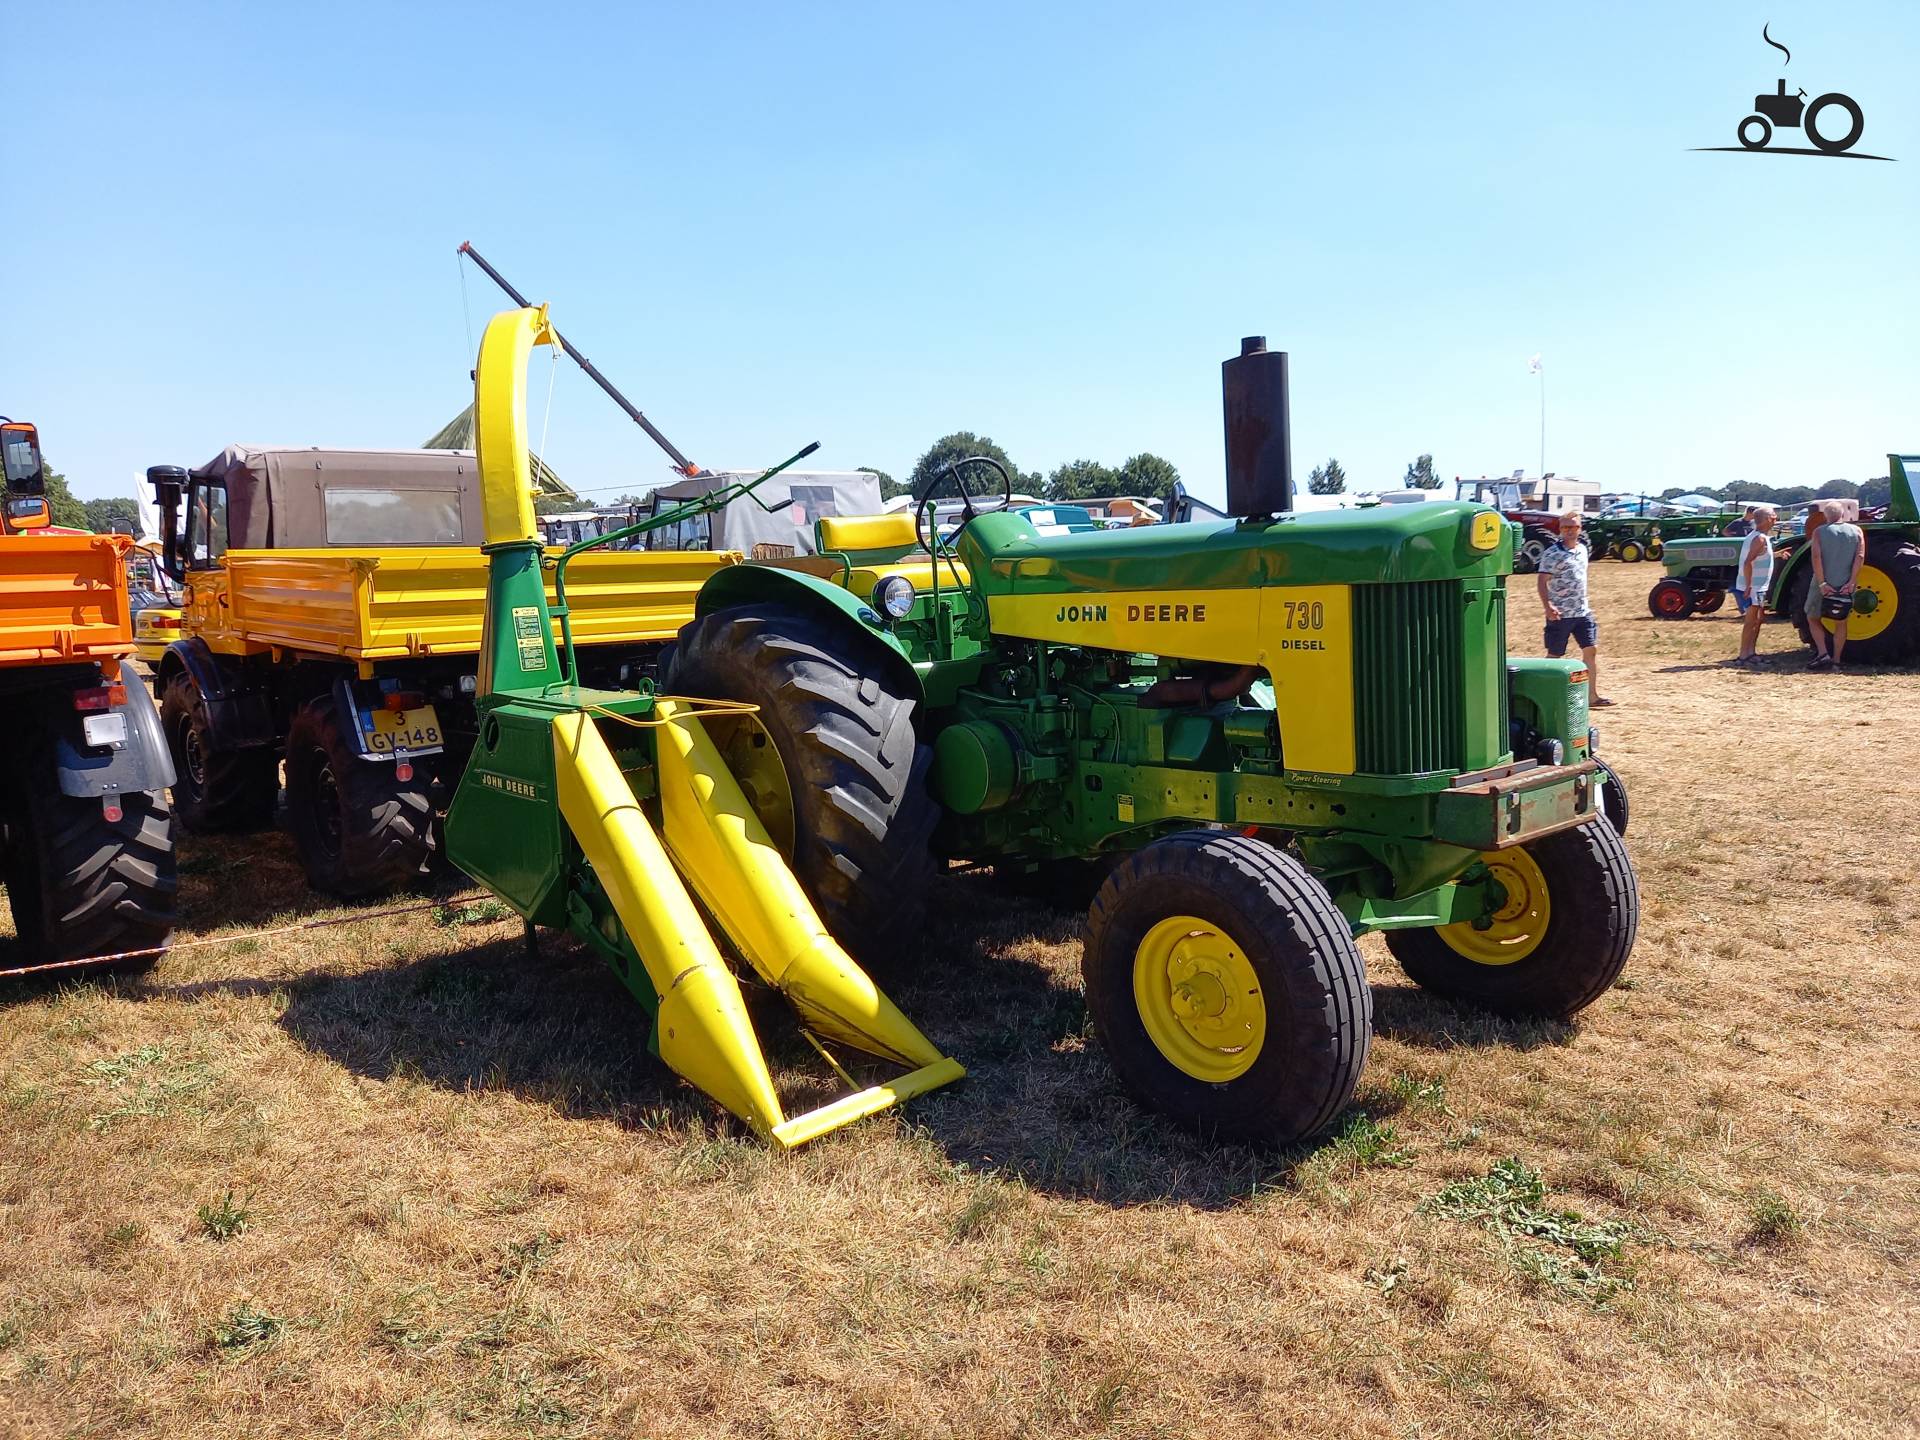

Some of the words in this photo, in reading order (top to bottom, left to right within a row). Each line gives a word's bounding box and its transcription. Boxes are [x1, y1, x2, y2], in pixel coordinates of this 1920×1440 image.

[1056, 605, 1107, 622] JOHN
[1127, 604, 1206, 622] DEERE
[1283, 601, 1324, 630] 730
[1281, 639, 1326, 651] DIESEL
[394, 711, 406, 726] 3
[371, 727, 438, 749] GV-148
[482, 773, 503, 789] JOHN
[506, 779, 535, 797] DEERE
[1291, 772, 1312, 783] Power
[1312, 774, 1342, 787] Steering
